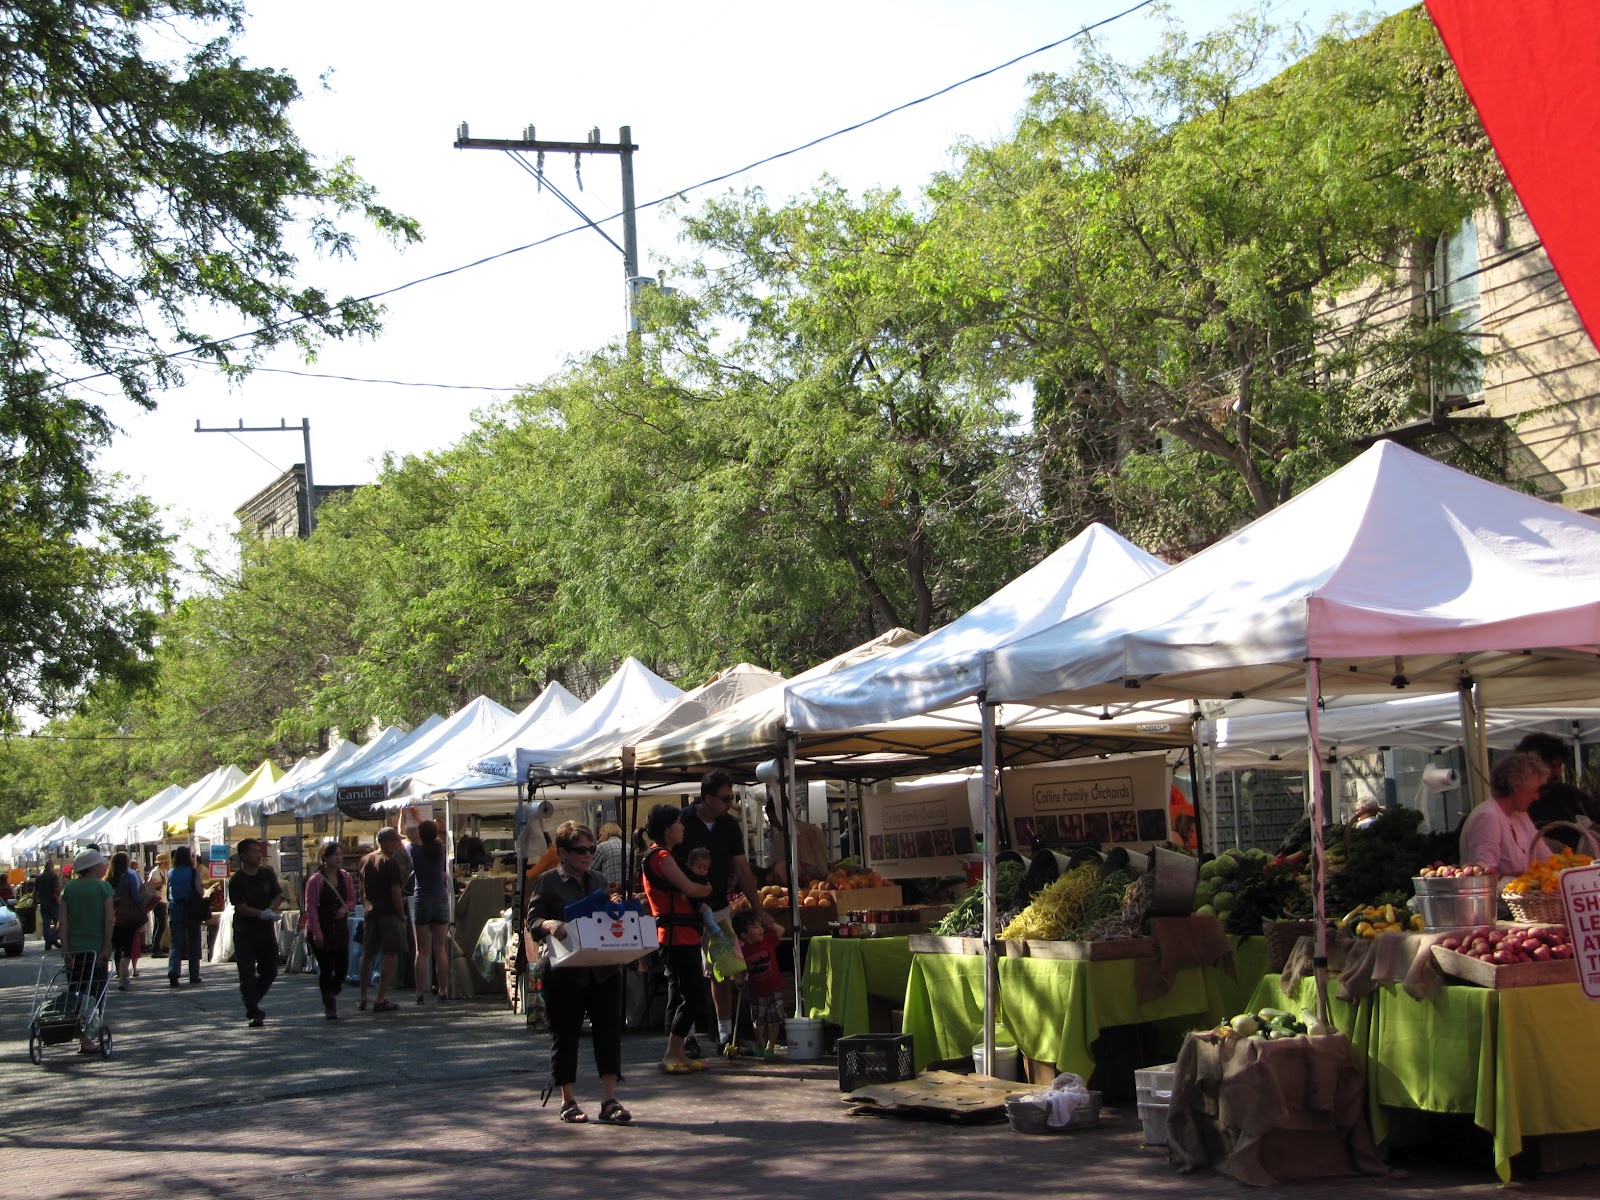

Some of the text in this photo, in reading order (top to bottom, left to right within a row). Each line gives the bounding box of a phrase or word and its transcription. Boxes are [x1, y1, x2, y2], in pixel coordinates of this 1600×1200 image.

[338, 787, 384, 800] Candles
[1036, 783, 1130, 804] Collins Family Orchards
